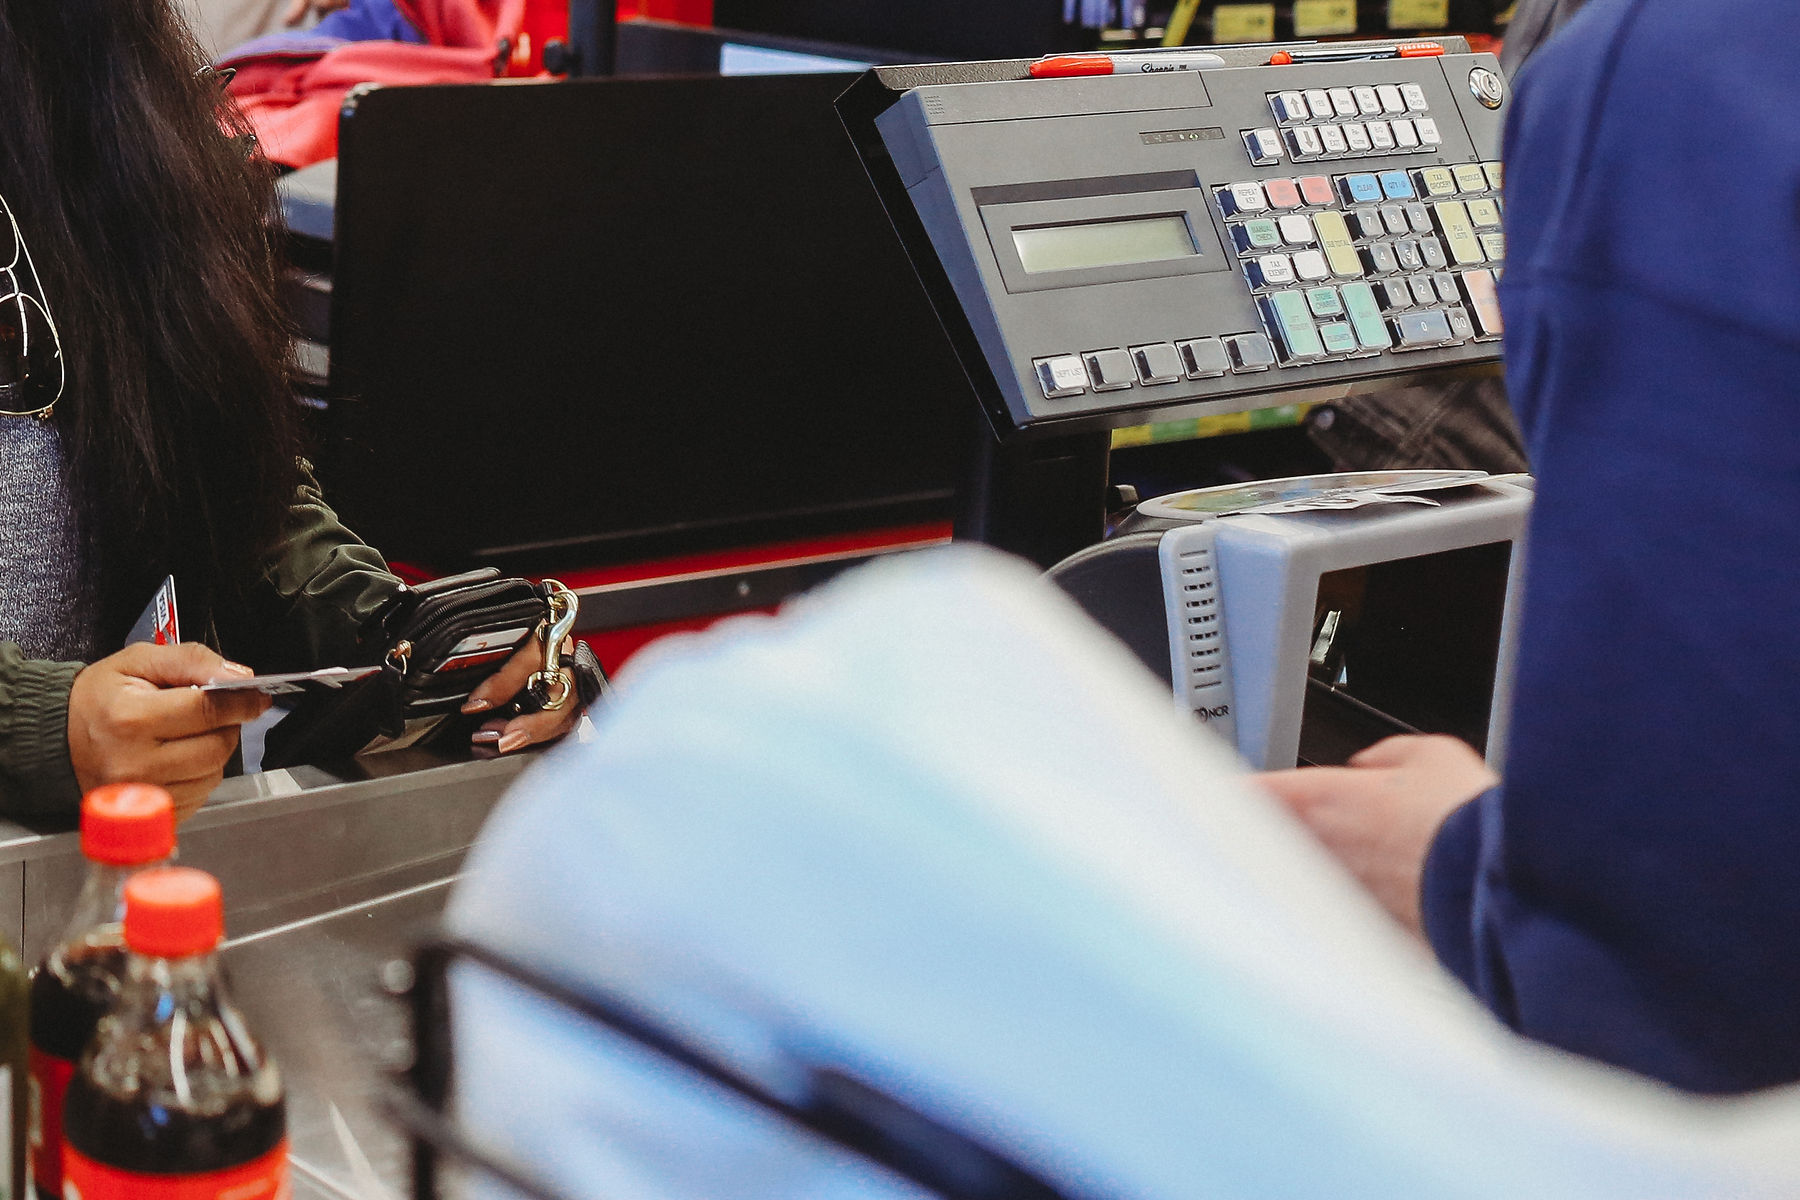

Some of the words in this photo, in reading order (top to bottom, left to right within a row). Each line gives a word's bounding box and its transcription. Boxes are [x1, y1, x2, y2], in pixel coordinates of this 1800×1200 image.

[1459, 173, 1481, 182] PRODUCE
[1356, 183, 1373, 192] CLEAR
[1430, 181, 1452, 190] GROCERY
[1366, 216, 1373, 226] 7
[1391, 215, 1398, 225] 8
[1415, 211, 1422, 221] 9
[1255, 233, 1273, 241] CHECK
[1380, 252, 1387, 261] 4
[1404, 249, 1412, 259] 5
[1429, 247, 1436, 257] 6
[1270, 260, 1281, 268] TAX
[1268, 267, 1288, 277] EXEMPT
[1419, 284, 1426, 294] 2
[1442, 281, 1449, 291] 3
[1393, 287, 1400, 297] 1
[1420, 321, 1428, 332] 0
[1453, 317, 1467, 328] 00
